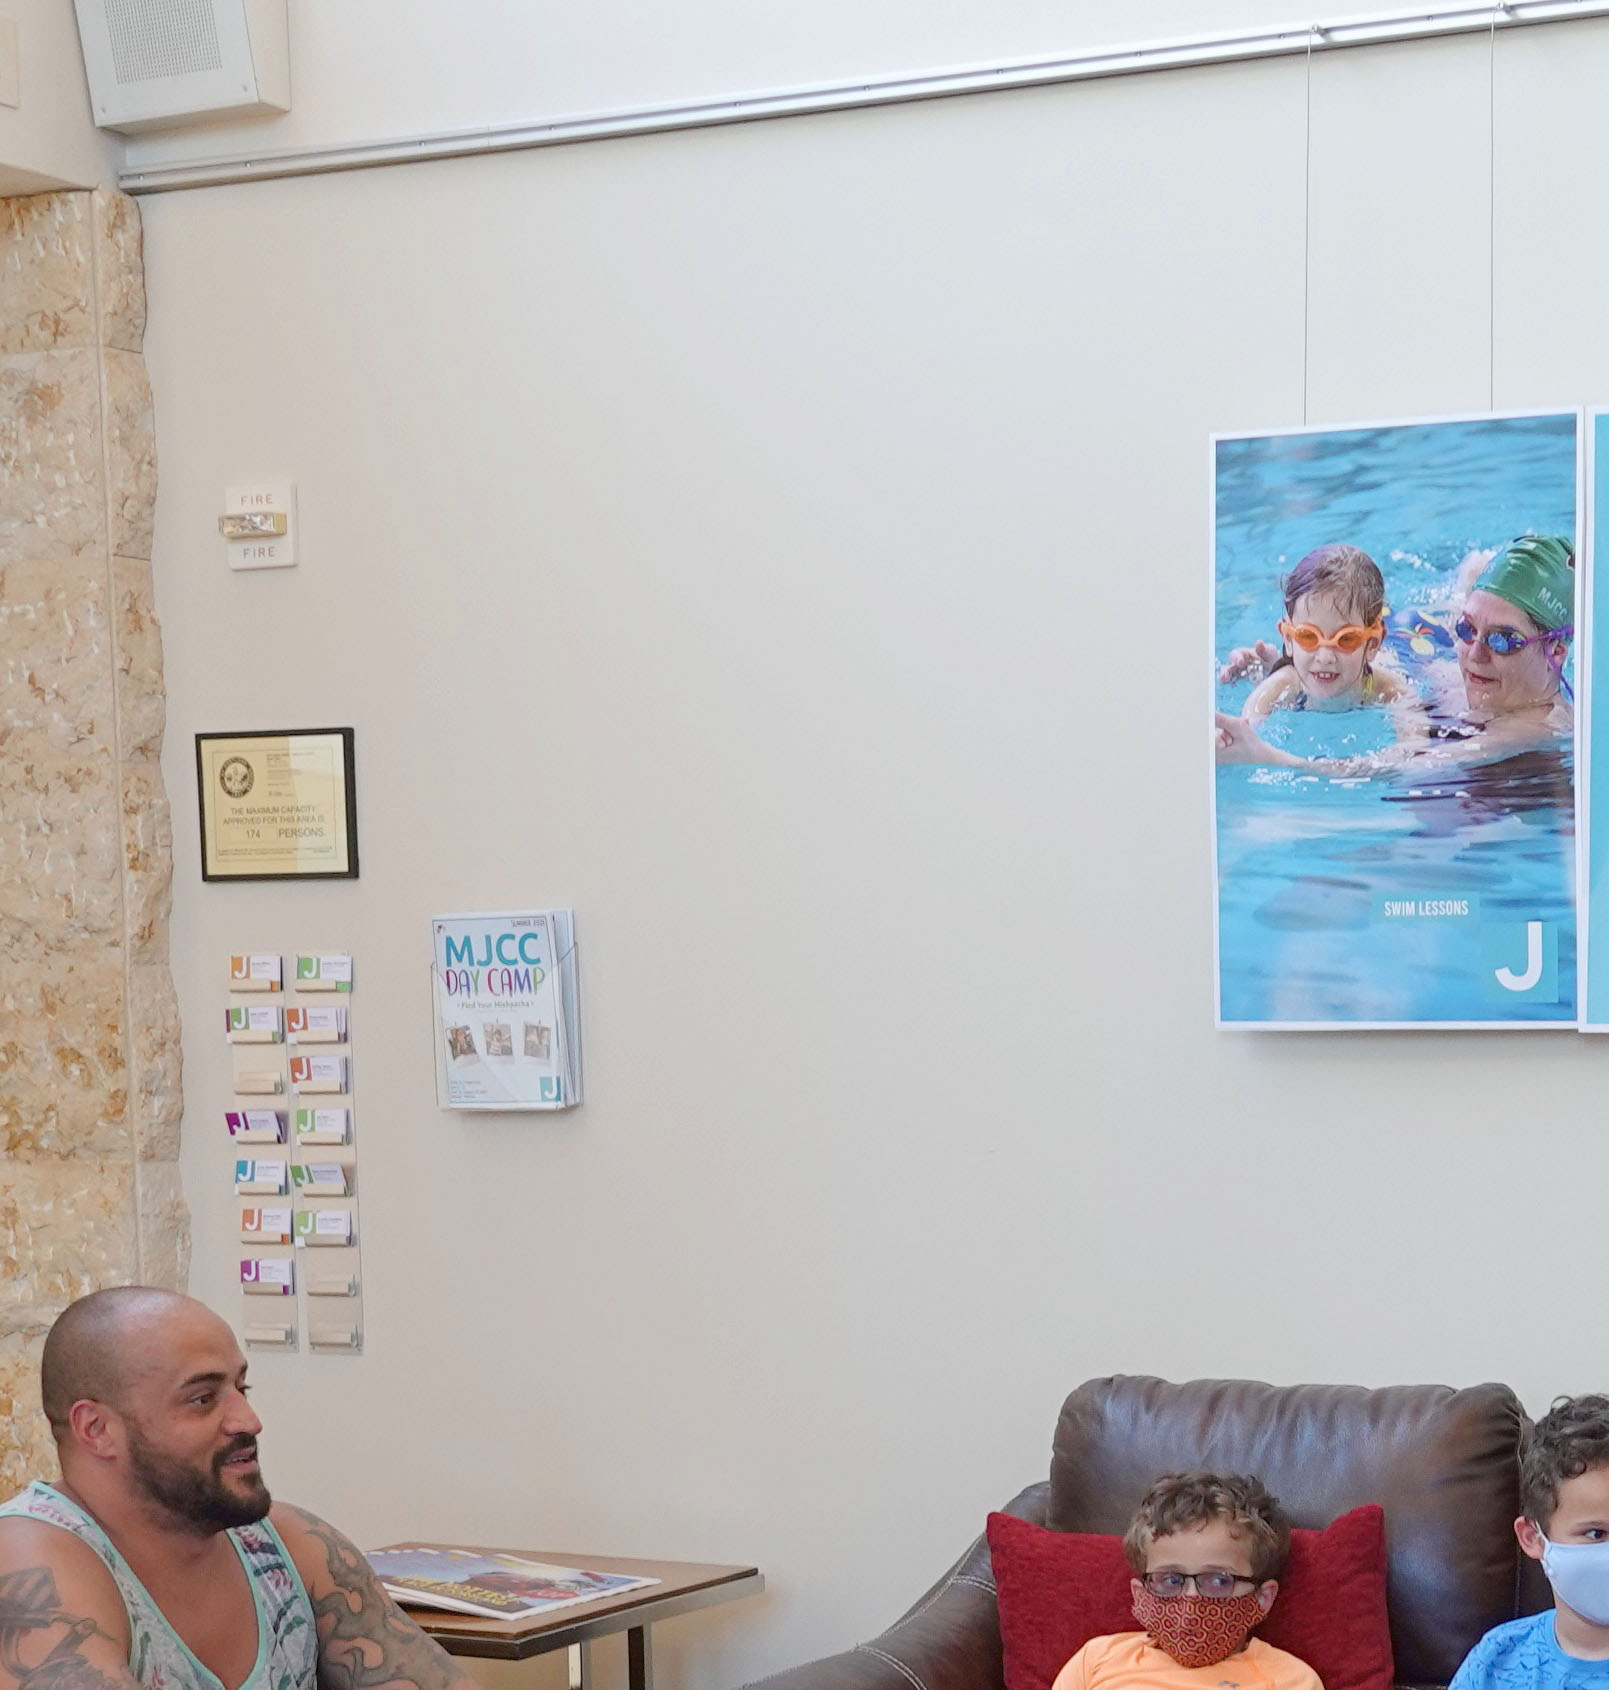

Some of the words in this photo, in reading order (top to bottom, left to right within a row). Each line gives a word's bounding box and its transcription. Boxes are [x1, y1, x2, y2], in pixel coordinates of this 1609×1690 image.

[240, 494, 273, 505] FIRE
[243, 547, 275, 558] FIRE
[246, 829, 260, 838] 174
[1384, 902, 1415, 916] SWIM
[1419, 900, 1468, 915] LESSONS
[445, 932, 541, 967] MJCC
[1495, 922, 1542, 992] J
[446, 968, 480, 998] DAY
[487, 967, 546, 997] CAMP
